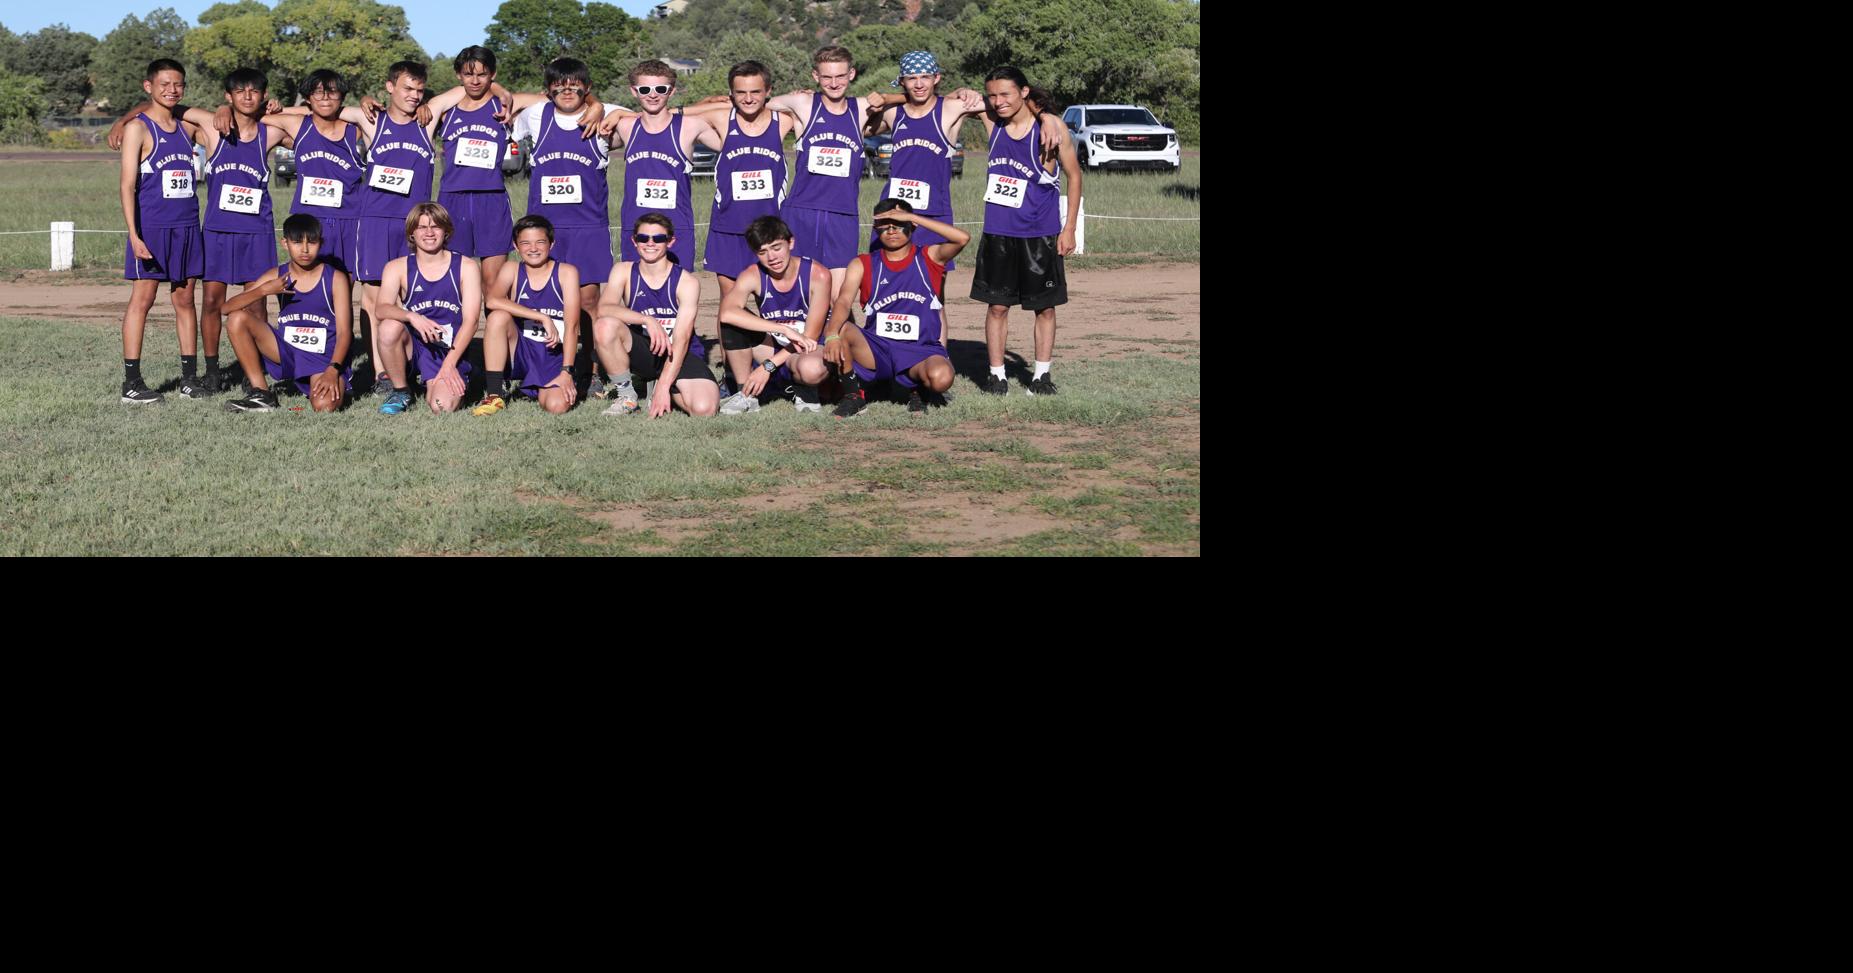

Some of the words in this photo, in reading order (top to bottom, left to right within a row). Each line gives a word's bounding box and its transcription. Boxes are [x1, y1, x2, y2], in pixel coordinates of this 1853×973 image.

[447, 126, 469, 141] BLUE
[470, 124, 498, 138] RIDGE
[809, 132, 834, 145] BLUE
[835, 133, 860, 153] RIDGE
[914, 138, 942, 155] RIDGE
[376, 142, 401, 155] BLUE
[402, 142, 430, 159] RIDGE
[463, 146, 490, 159] 328
[726, 147, 751, 160] BLUE
[753, 146, 781, 162] RIDGE
[155, 154, 177, 169] BLUE
[300, 151, 324, 163] BLUE
[324, 152, 352, 171] RIDGE
[537, 152, 562, 165] BLUE
[563, 152, 593, 167] RIDGE
[626, 151, 650, 165] BLUE
[651, 151, 680, 168] RIDGE
[816, 156, 843, 168] 325
[238, 163, 263, 182] RIDGE
[383, 167, 404, 176] GILL
[741, 171, 762, 179] GILL
[170, 178, 189, 190] 318
[312, 178, 333, 186] GILL
[378, 174, 406, 186] 327
[741, 179, 766, 191] 333
[998, 176, 1018, 185] GILL
[231, 186, 252, 195] GILL
[309, 186, 335, 198] 324
[548, 184, 575, 195] 320
[644, 187, 669, 200] 332
[897, 187, 921, 200] 321
[994, 183, 1018, 198] 322
[227, 193, 254, 206] 326
[873, 293, 898, 311] BLUE
[898, 291, 926, 304] RIDGE
[540, 308, 564, 318] RIDG
[656, 307, 674, 315] RID
[762, 310, 782, 320] LUE
[302, 313, 330, 327] RIDGE
[884, 321, 912, 334] 330
[291, 334, 319, 345] 329
